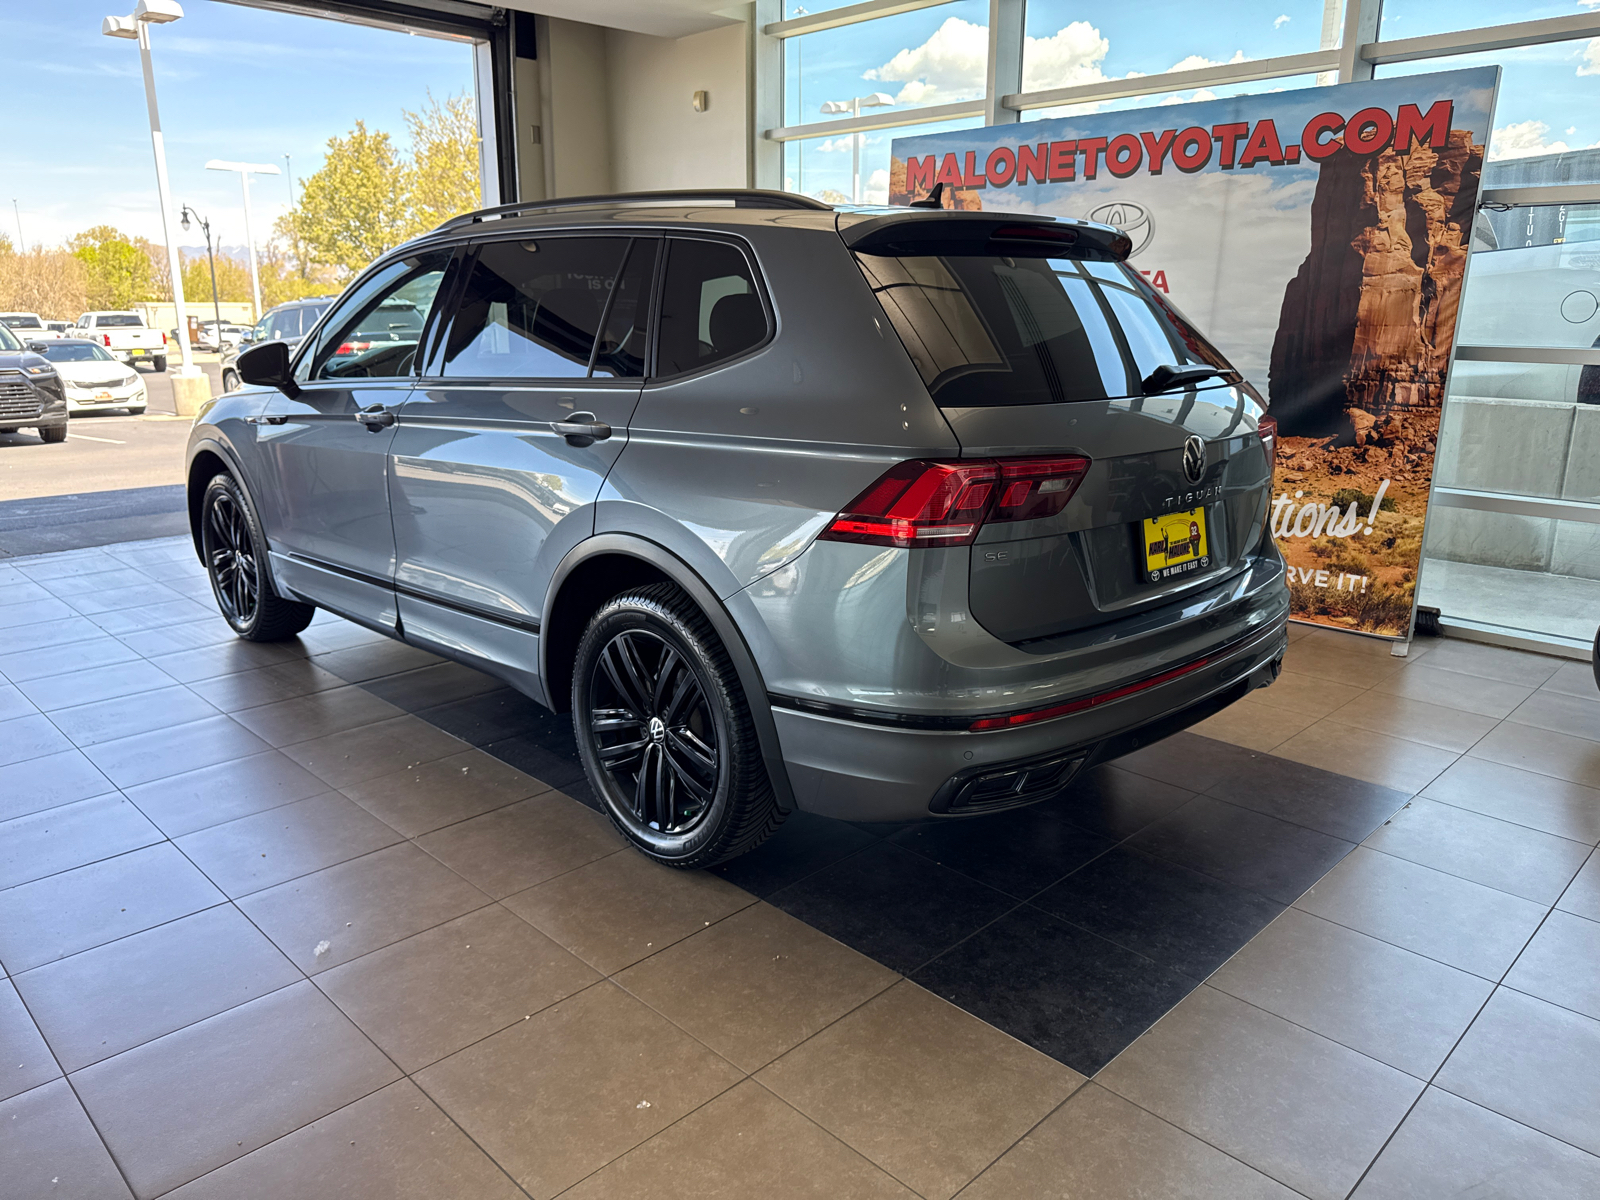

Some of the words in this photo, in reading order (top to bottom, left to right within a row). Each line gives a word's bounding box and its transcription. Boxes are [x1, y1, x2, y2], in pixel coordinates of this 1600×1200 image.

[906, 100, 1455, 192] MALONETOYOTA.COM
[1165, 485, 1222, 508] TIGUAN
[1271, 479, 1390, 538] tions!
[984, 551, 1008, 562] SE
[1163, 567, 1170, 577] WE
[1187, 560, 1198, 570] EASY
[1286, 566, 1330, 588] RVE
[1337, 573, 1368, 594] IT!
